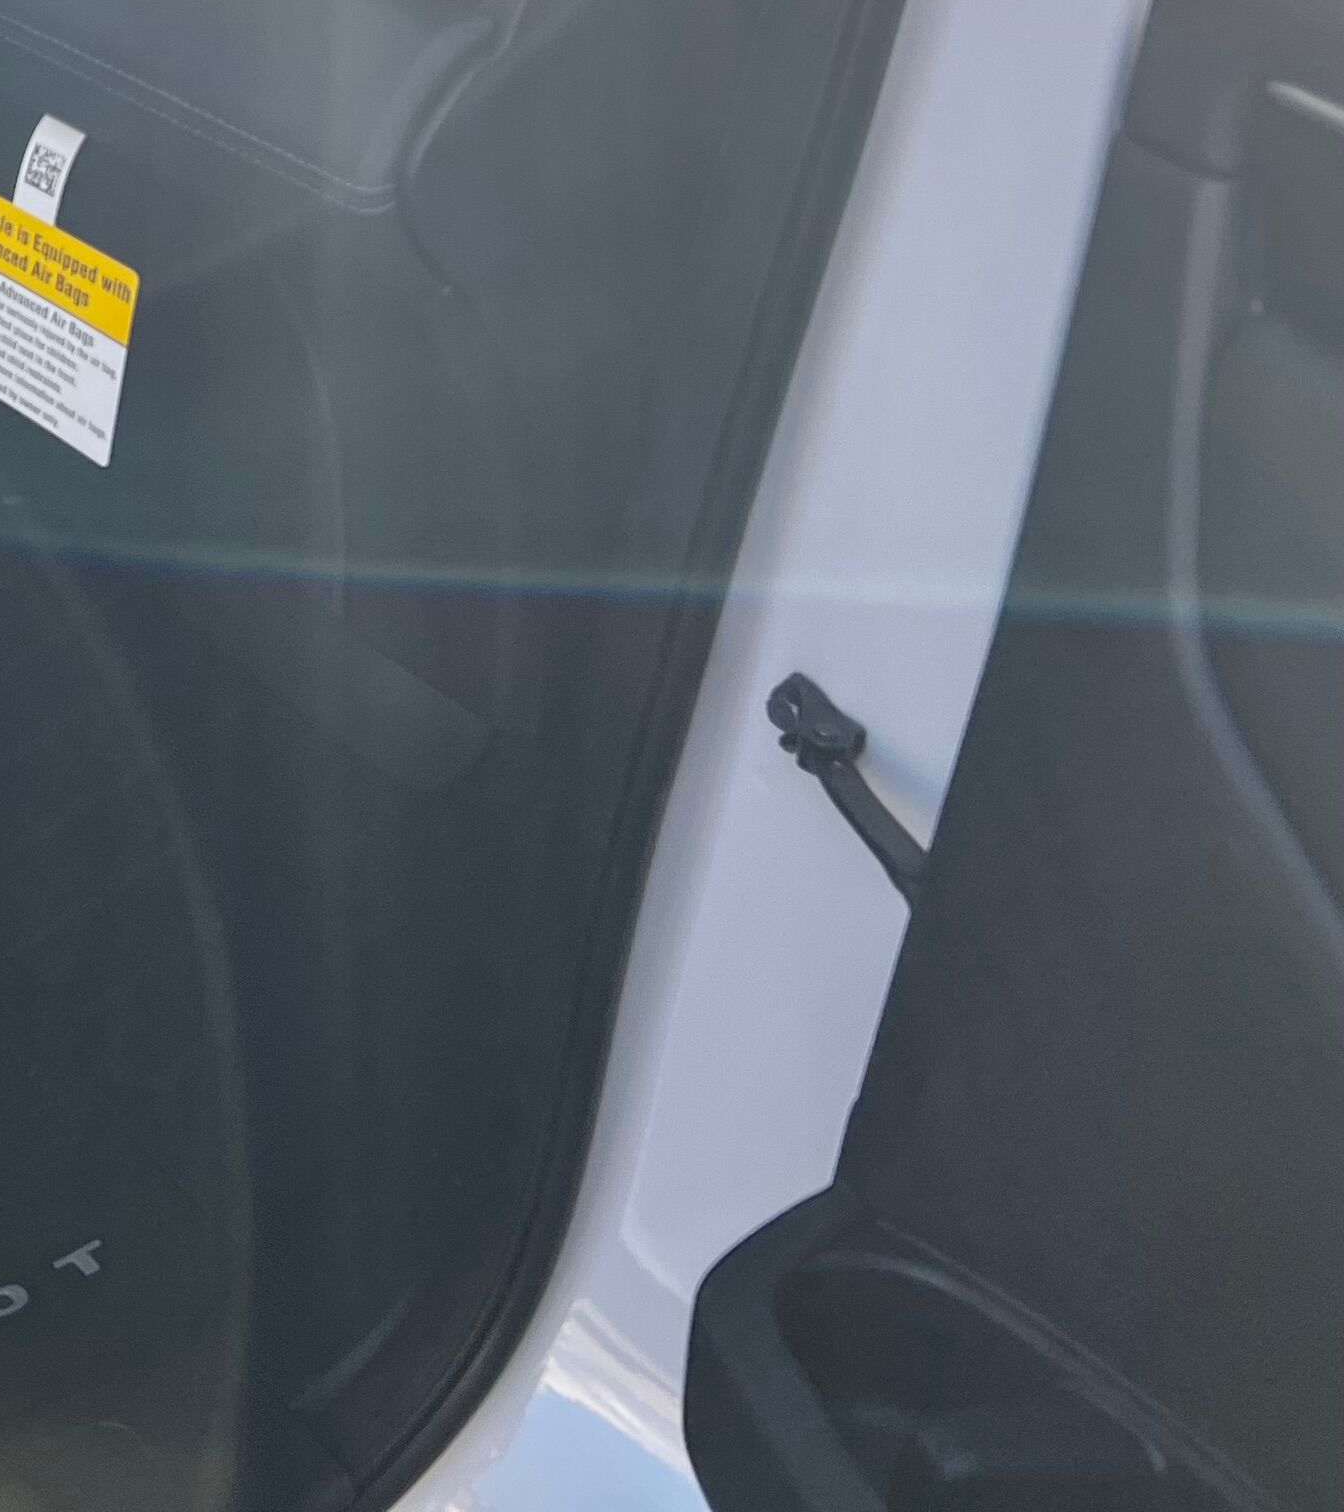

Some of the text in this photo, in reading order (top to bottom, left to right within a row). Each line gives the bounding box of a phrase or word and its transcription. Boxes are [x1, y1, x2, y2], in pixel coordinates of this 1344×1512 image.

[17, 226, 29, 246] is
[33, 232, 98, 285] Equipped
[101, 272, 132, 304] with
[31, 260, 52, 285] Air
[55, 273, 90, 307] Bags
[0, 280, 49, 319] Advanced
[50, 311, 68, 329] Air
[68, 321, 95, 348] Bags
